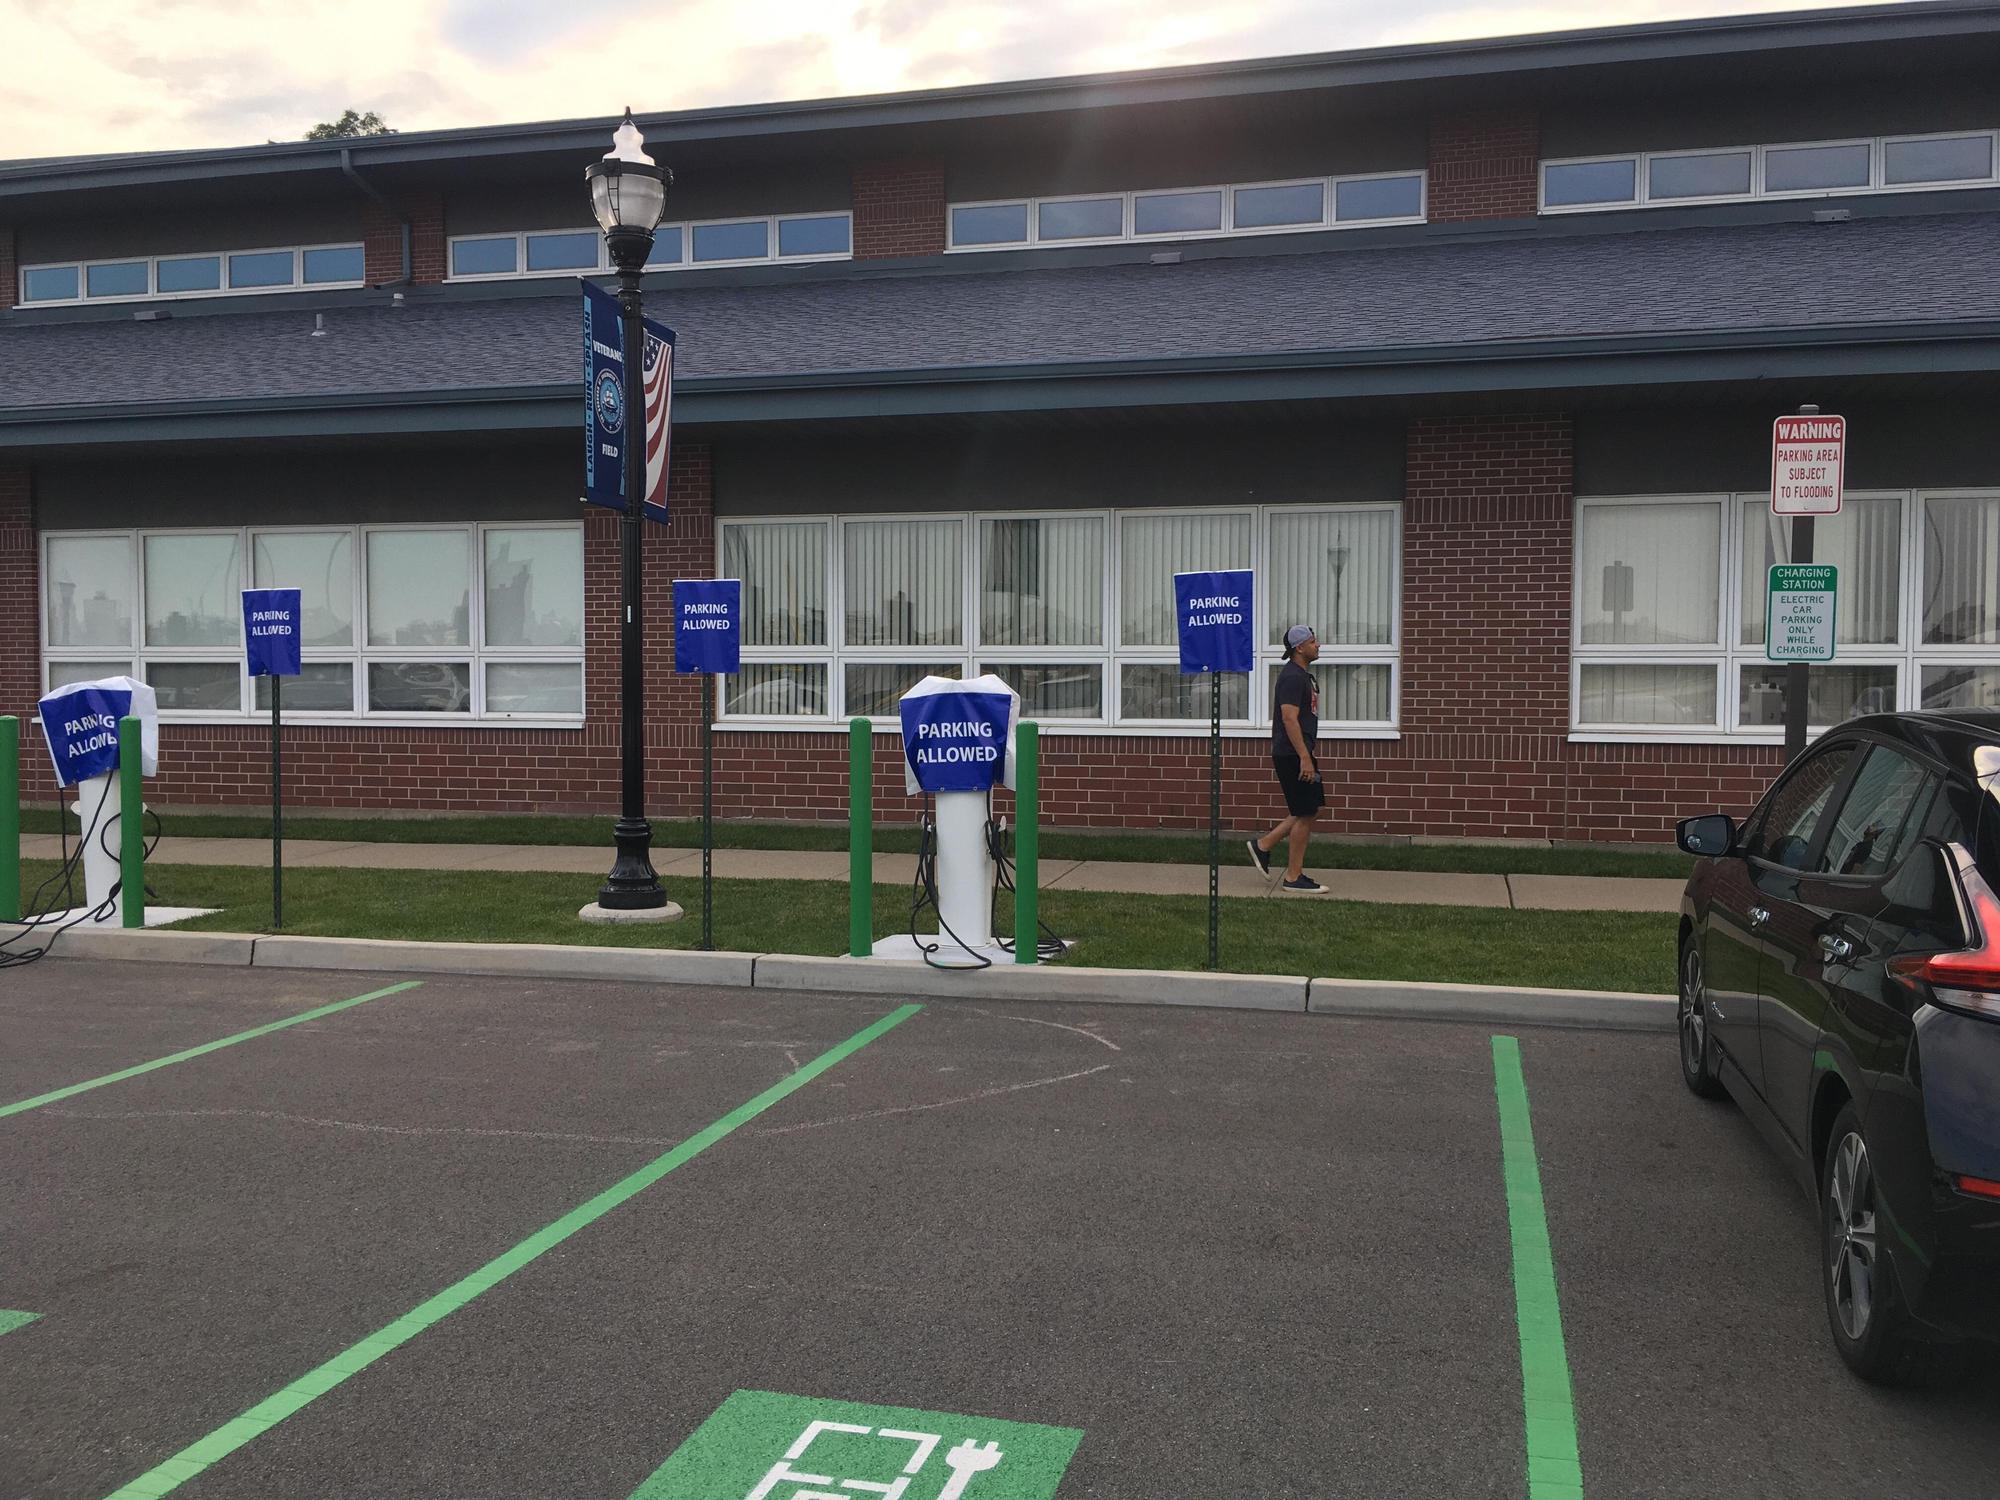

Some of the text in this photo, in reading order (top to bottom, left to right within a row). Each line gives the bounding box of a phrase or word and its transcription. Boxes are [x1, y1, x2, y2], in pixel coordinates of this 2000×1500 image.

[592, 339, 622, 362] VETERANS
[1778, 422, 1841, 439] WARNING
[602, 443, 618, 458] FIELD
[1778, 449, 1839, 462] PARKING AREA
[1789, 467, 1827, 480] SUBJECT
[1781, 486, 1834, 498] TO FLOODING
[1777, 568, 1831, 578] CHARGING
[1782, 580, 1825, 589] STATION
[1189, 596, 1240, 610] PARKING
[1780, 595, 1825, 604] ELECTRIC
[684, 603, 728, 615] PARKING
[1792, 606, 1812, 614] CAR
[682, 619, 730, 630] ALLOWED
[1188, 613, 1242, 627] ALLOWED
[1781, 615, 1823, 624] PARKING
[1788, 626, 1815, 634] ONLY
[1787, 636, 1816, 644] WHILE
[1776, 646, 1825, 654] CHARGING
[918, 721, 993, 739] PARKING
[917, 746, 998, 764] ALLOWED
